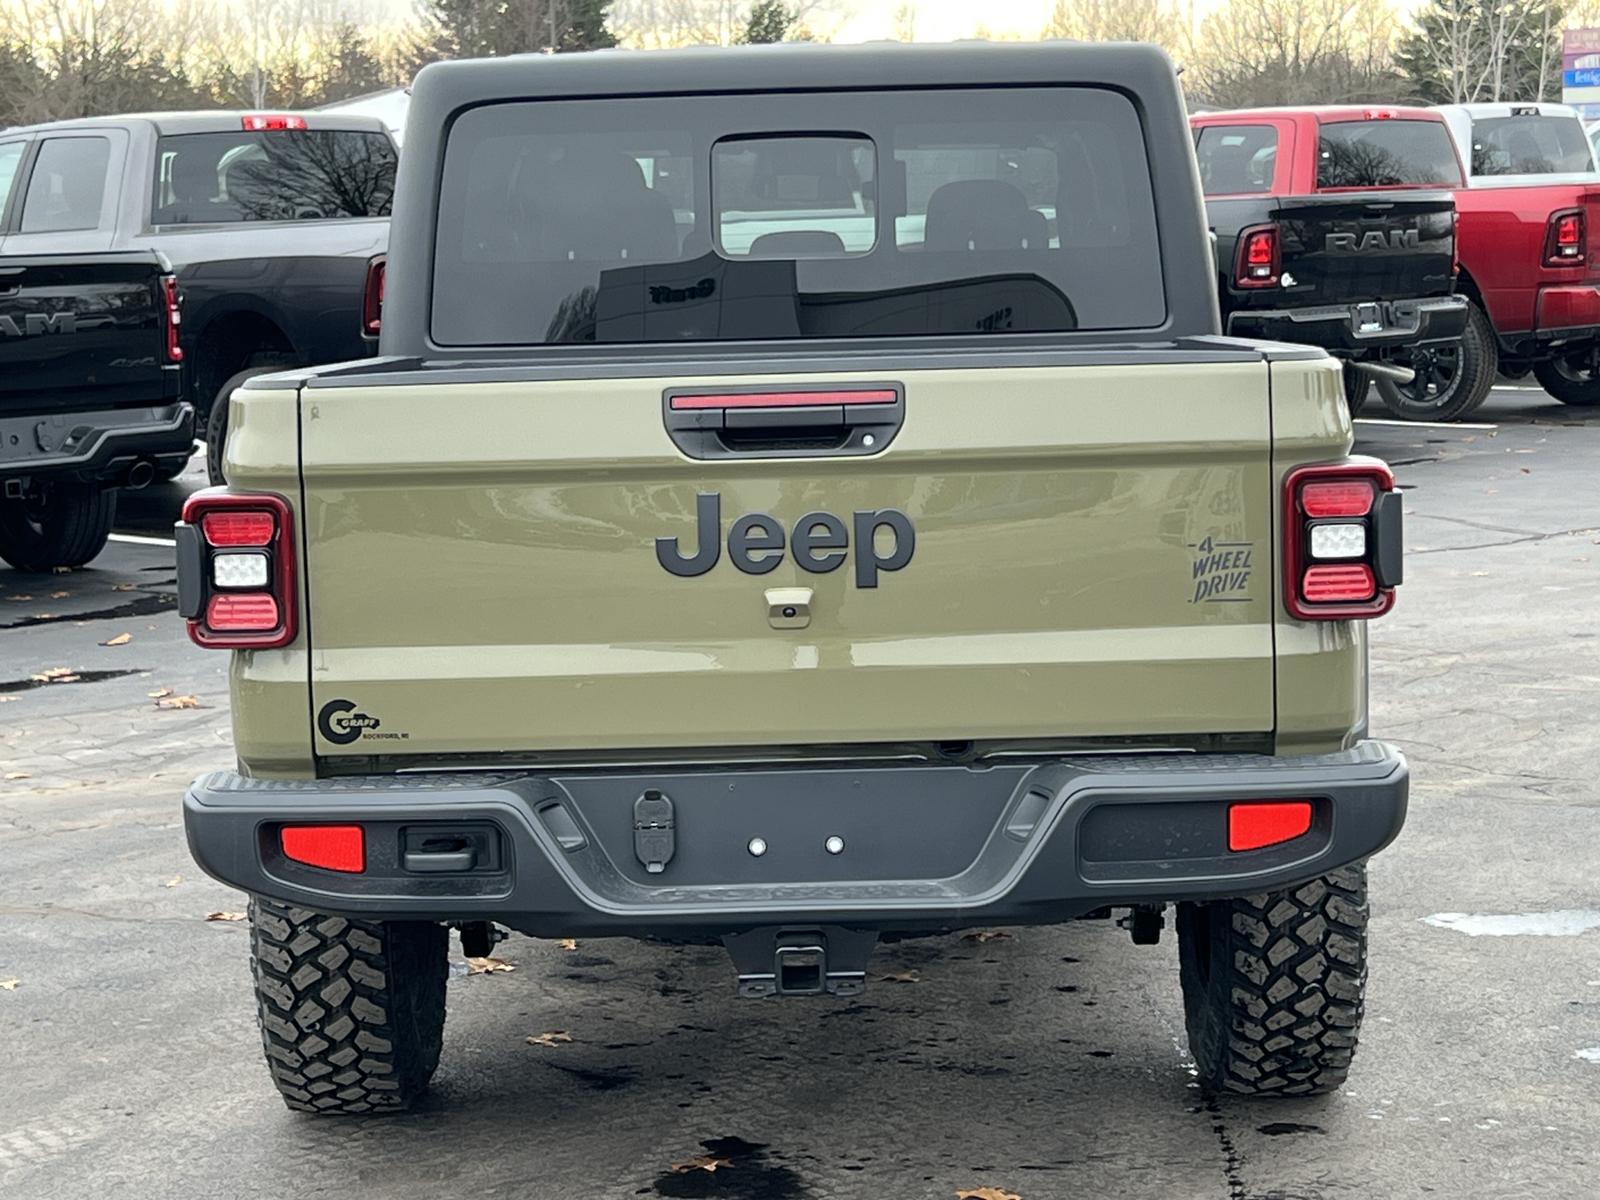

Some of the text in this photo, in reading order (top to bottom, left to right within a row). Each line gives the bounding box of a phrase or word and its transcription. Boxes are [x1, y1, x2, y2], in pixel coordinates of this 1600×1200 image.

[1325, 229, 1419, 251] RAM
[0, 312, 77, 336] AM
[655, 492, 916, 588] Jeep
[1198, 536, 1214, 554] 4
[1193, 551, 1252, 579] WHEEL
[1193, 571, 1252, 604] DRIVE
